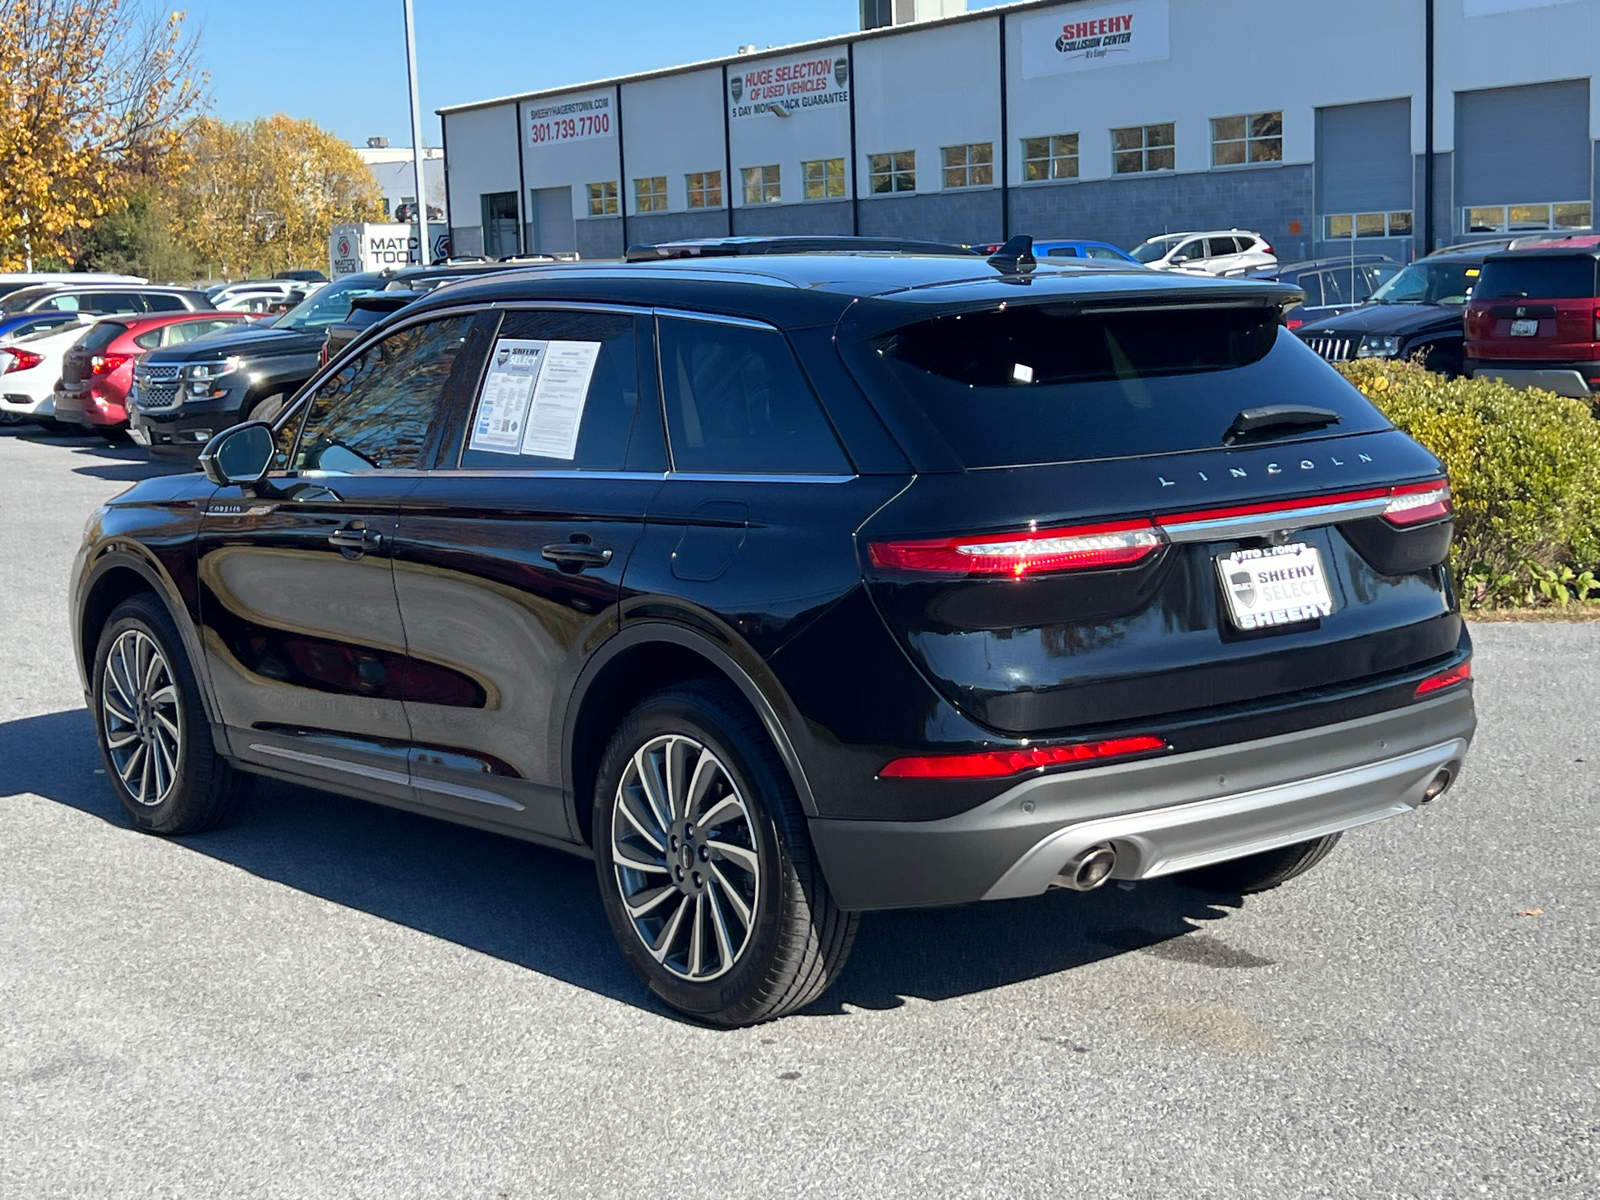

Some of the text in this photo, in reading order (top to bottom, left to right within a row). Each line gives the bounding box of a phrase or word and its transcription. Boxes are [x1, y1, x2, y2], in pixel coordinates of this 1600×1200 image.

[1063, 13, 1133, 41] SHEEHY
[1063, 32, 1132, 53] COLLISION CENTER
[745, 58, 832, 88] HUGE SELECTION
[750, 77, 827, 101] OF USED VEHICLES
[530, 97, 609, 120] SHEEHYHAGERSTOWN.COM
[732, 108, 737, 118] 5
[738, 105, 752, 117] DAY
[802, 91, 848, 107] GUARANTEE
[532, 113, 609, 143] 301.739.7700
[371, 238, 430, 250] MATC
[371, 251, 430, 264] TOOL
[509, 355, 538, 366] SELECT
[512, 348, 540, 356] SHEEHY
[1158, 453, 1373, 487] LINCOLN
[1230, 549, 1262, 562] AUTO
[1257, 564, 1315, 584] SHEEHY
[1262, 579, 1320, 602] SELECT
[1240, 603, 1333, 629] SHEEHY
